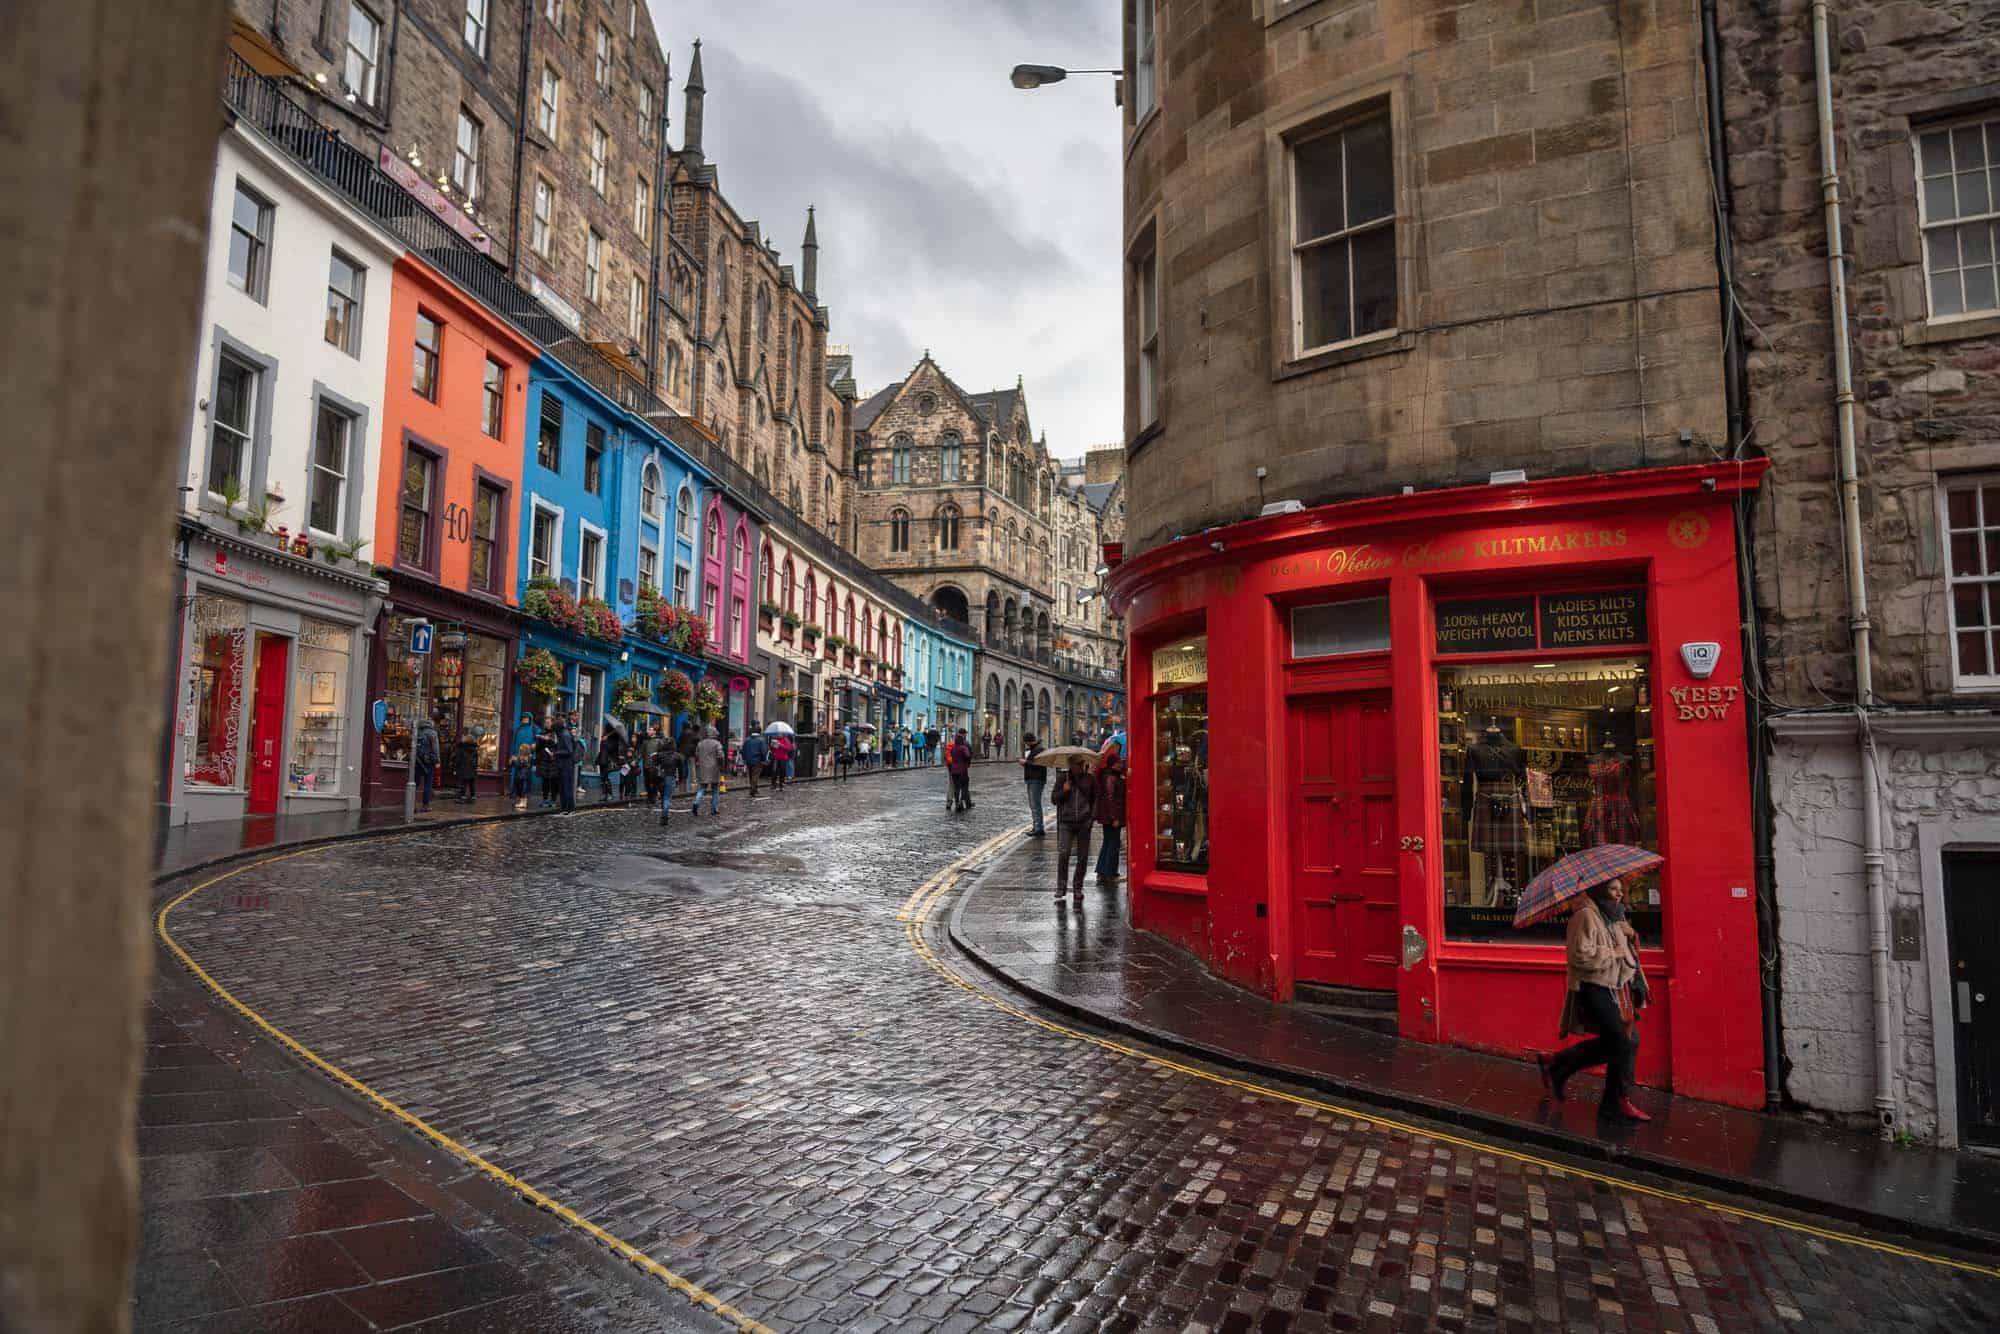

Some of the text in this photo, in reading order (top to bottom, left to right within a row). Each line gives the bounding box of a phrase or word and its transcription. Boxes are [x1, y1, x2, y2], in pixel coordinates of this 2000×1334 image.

[440, 502, 469, 544] 40
[1473, 528, 1628, 558] KILTMAKERS
[1549, 596, 1636, 614] LADIES KILTS
[1443, 612, 1526, 628] 100% HEAVY
[1557, 611, 1629, 628] KIDS KILTS
[1437, 625, 1536, 641] WEIGHT WOOL
[1553, 626, 1636, 643] MENS KILTS
[1532, 668, 1640, 688] SCOTLAND
[1670, 686, 1738, 704] WEST
[1400, 835, 1425, 850] 92
